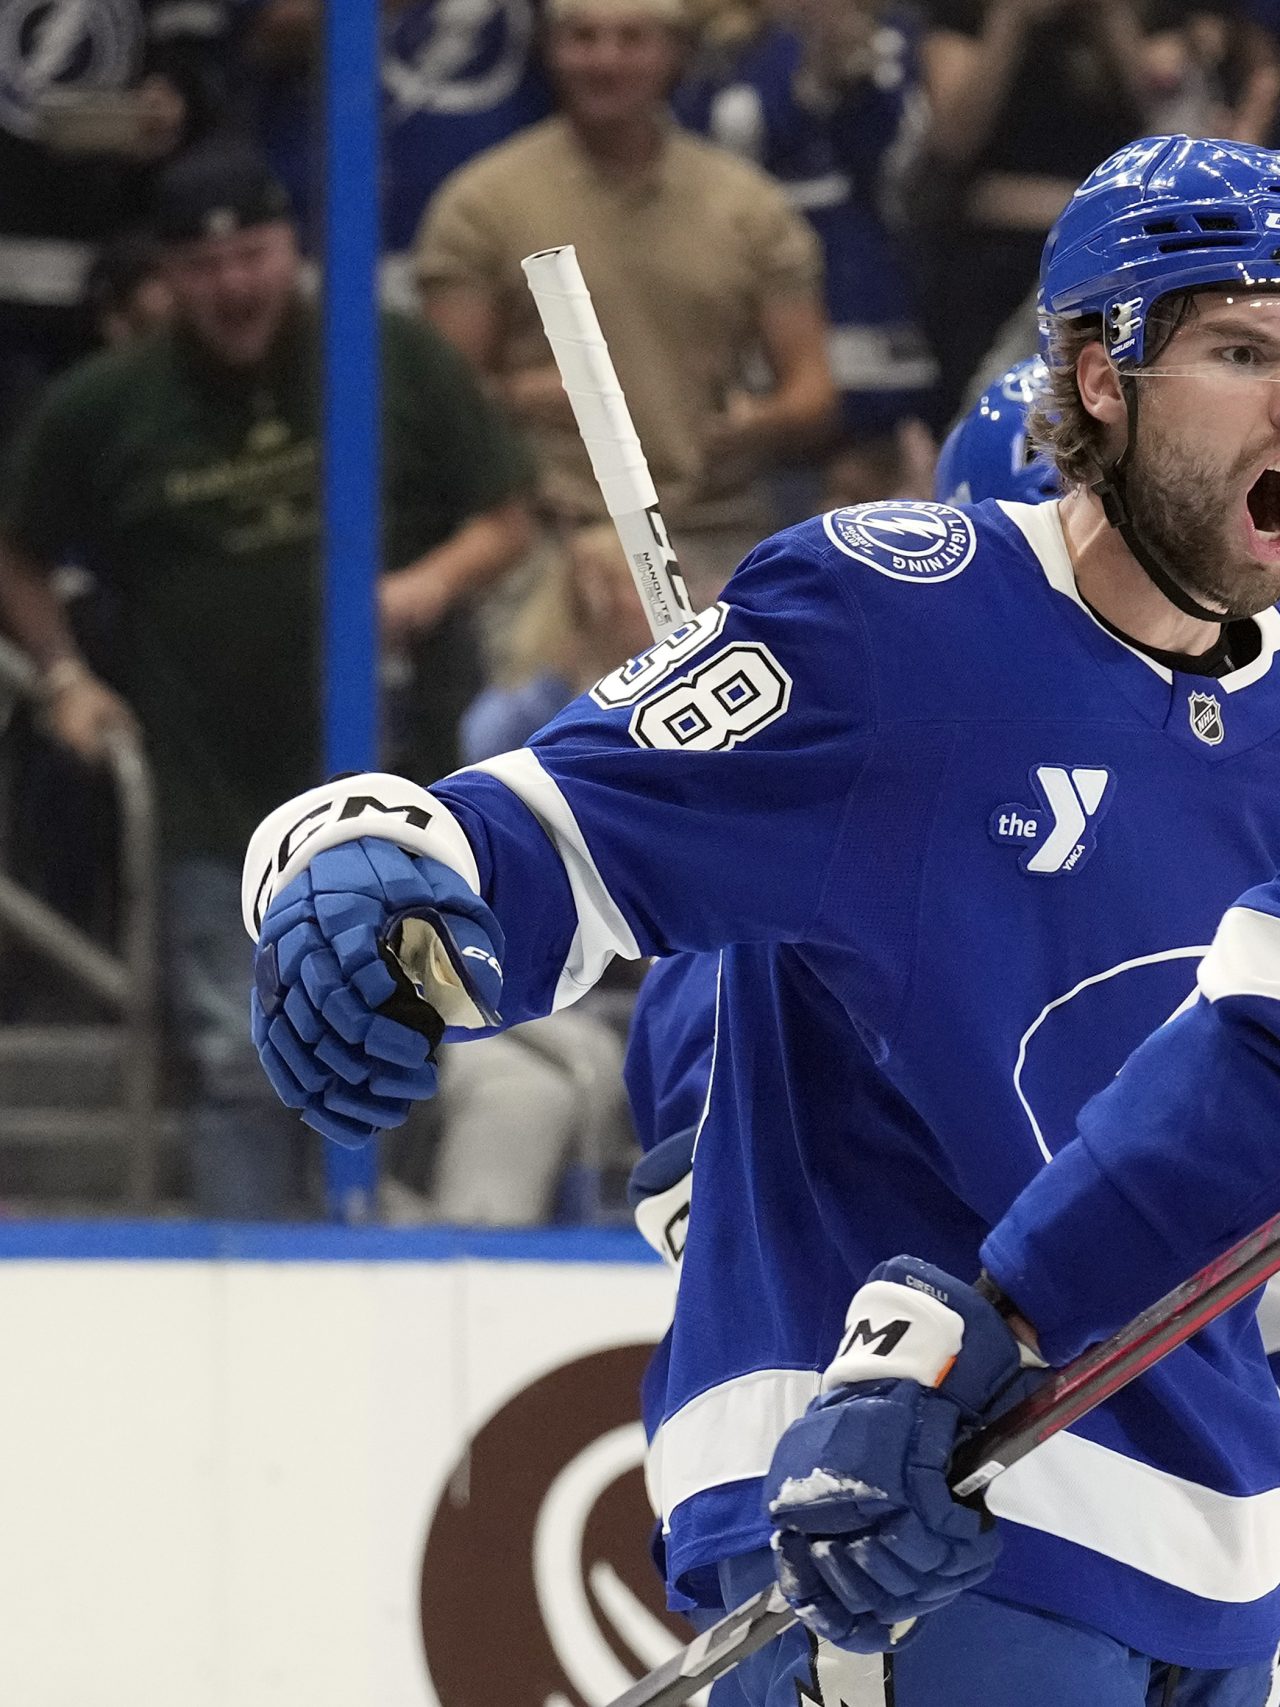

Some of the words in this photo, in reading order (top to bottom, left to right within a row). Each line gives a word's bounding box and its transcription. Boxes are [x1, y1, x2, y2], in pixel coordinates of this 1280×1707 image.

[892, 518, 967, 573] LIGHTNING
[642, 552, 672, 624] NANOLITE
[588, 601, 793, 752] 38
[1197, 709, 1216, 733] NHL
[998, 813, 1037, 837] the
[1062, 844, 1085, 871] YMCA
[905, 1274, 948, 1303] CIRELLI
